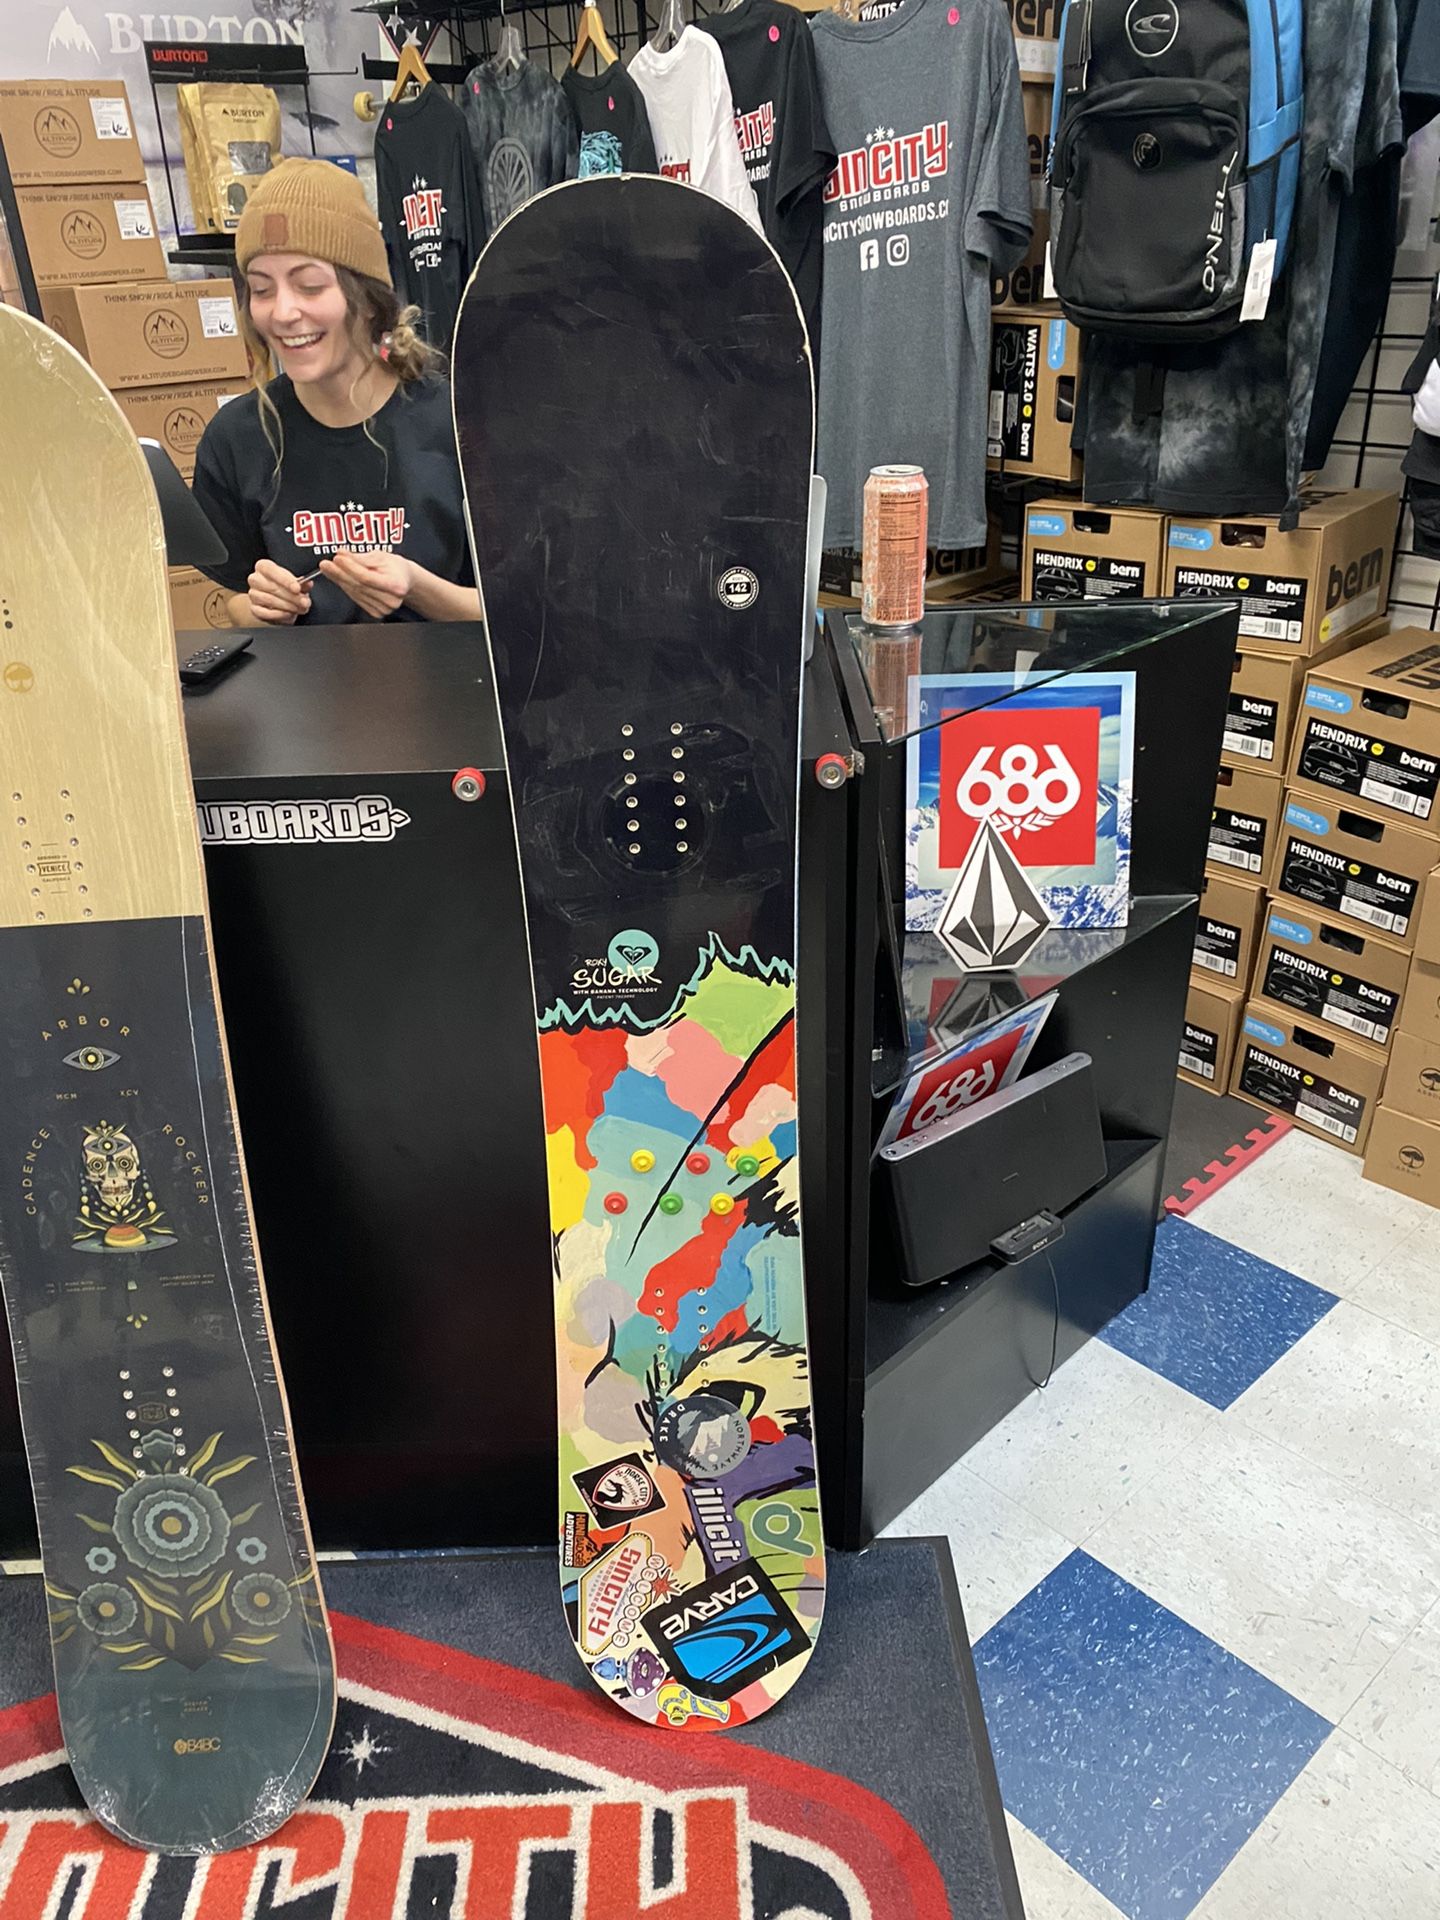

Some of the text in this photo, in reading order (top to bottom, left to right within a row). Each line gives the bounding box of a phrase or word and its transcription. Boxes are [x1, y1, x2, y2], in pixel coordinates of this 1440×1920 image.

[862, 2, 897, 21] WATTS
[105, 13, 304, 54] BURTON
[153, 50, 200, 63] BURTON
[230, 109, 265, 119] BURTON
[104, 295, 127, 303] THINK
[175, 290, 209, 298] ALTITUDE
[1023, 328, 1038, 402] WATTS 2.0
[126, 396, 149, 405] THINK
[194, 387, 228, 397] ALTITUDE
[1036, 553, 1083, 570] HENDRIX
[1110, 562, 1140, 578] bern
[729, 583, 747, 593] 142
[1178, 571, 1235, 589] HENDRIX
[1266, 580, 1301, 596] bern
[1326, 547, 1383, 611] bern
[1242, 699, 1273, 717] bern
[1310, 722, 1369, 752] HENDRIX
[1400, 752, 1437, 773] bern
[956, 744, 1081, 818] 686
[1230, 815, 1261, 832] bern
[1290, 842, 1346, 871] HENDRIX
[1376, 872, 1411, 894] bern
[1207, 922, 1236, 940] bern
[585, 958, 608, 967] ROXY
[1274, 950, 1329, 981] HENDRIX
[569, 965, 662, 988] SUGAR
[1358, 984, 1392, 1006] bern
[41, 1015, 130, 1041] ARBOR
[1185, 1027, 1213, 1045] bern
[1249, 1049, 1301, 1080] HENDRIX
[1328, 1086, 1360, 1108] bern
[22, 1128, 51, 1215] CADENCE
[162, 1123, 209, 1204] ROCKER
[660, 1403, 685, 1442] DRAKE
[712, 1420, 745, 1471] NORTHWAVE
[692, 1487, 742, 1563] illicit
[565, 1513, 575, 1567] ADVENTURES
[614, 1556, 662, 1645] WELCOME
